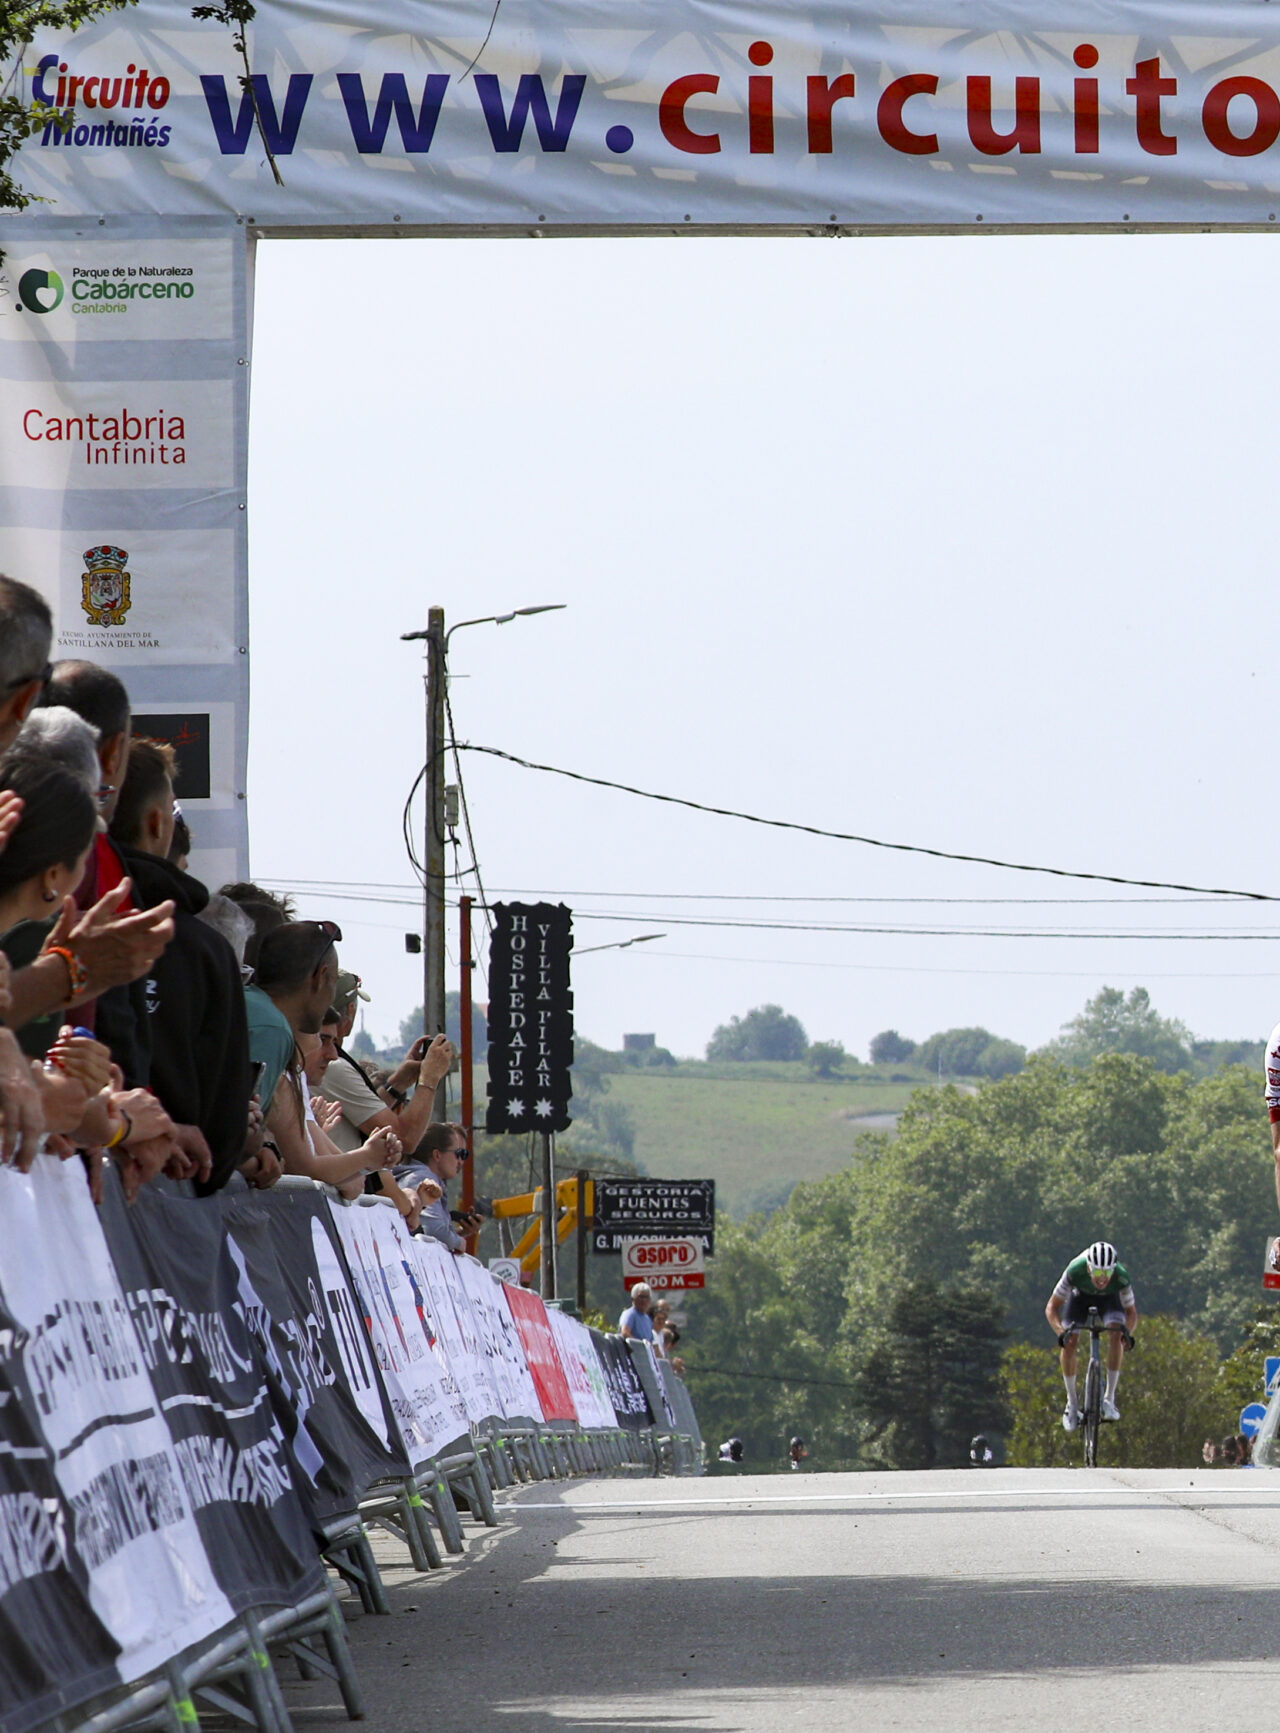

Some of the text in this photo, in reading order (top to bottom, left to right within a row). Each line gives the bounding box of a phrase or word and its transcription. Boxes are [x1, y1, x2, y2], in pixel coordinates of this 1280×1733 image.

[32, 54, 170, 109] Circuito
[40, 109, 172, 147] Montañés
[73, 266, 193, 279] Parque de la Naturaleza
[72, 278, 194, 300] Cabárceno
[72, 303, 127, 314] Cantabria
[23, 408, 185, 441] Cantabria
[86, 441, 186, 465] Infinita
[57, 639, 160, 648] SANTILLANA DEL MAR
[508, 915, 528, 1087] HOSPEDAJE
[536, 924, 551, 1087] VILLA PILAR
[605, 1187, 703, 1196] GESTORIA
[619, 1197, 690, 1209] FUENTES
[611, 1211, 701, 1219] SEGUROS
[596, 1235, 609, 1248] G.
[637, 1246, 688, 1266] aspro
[671, 1276, 685, 1287] M
